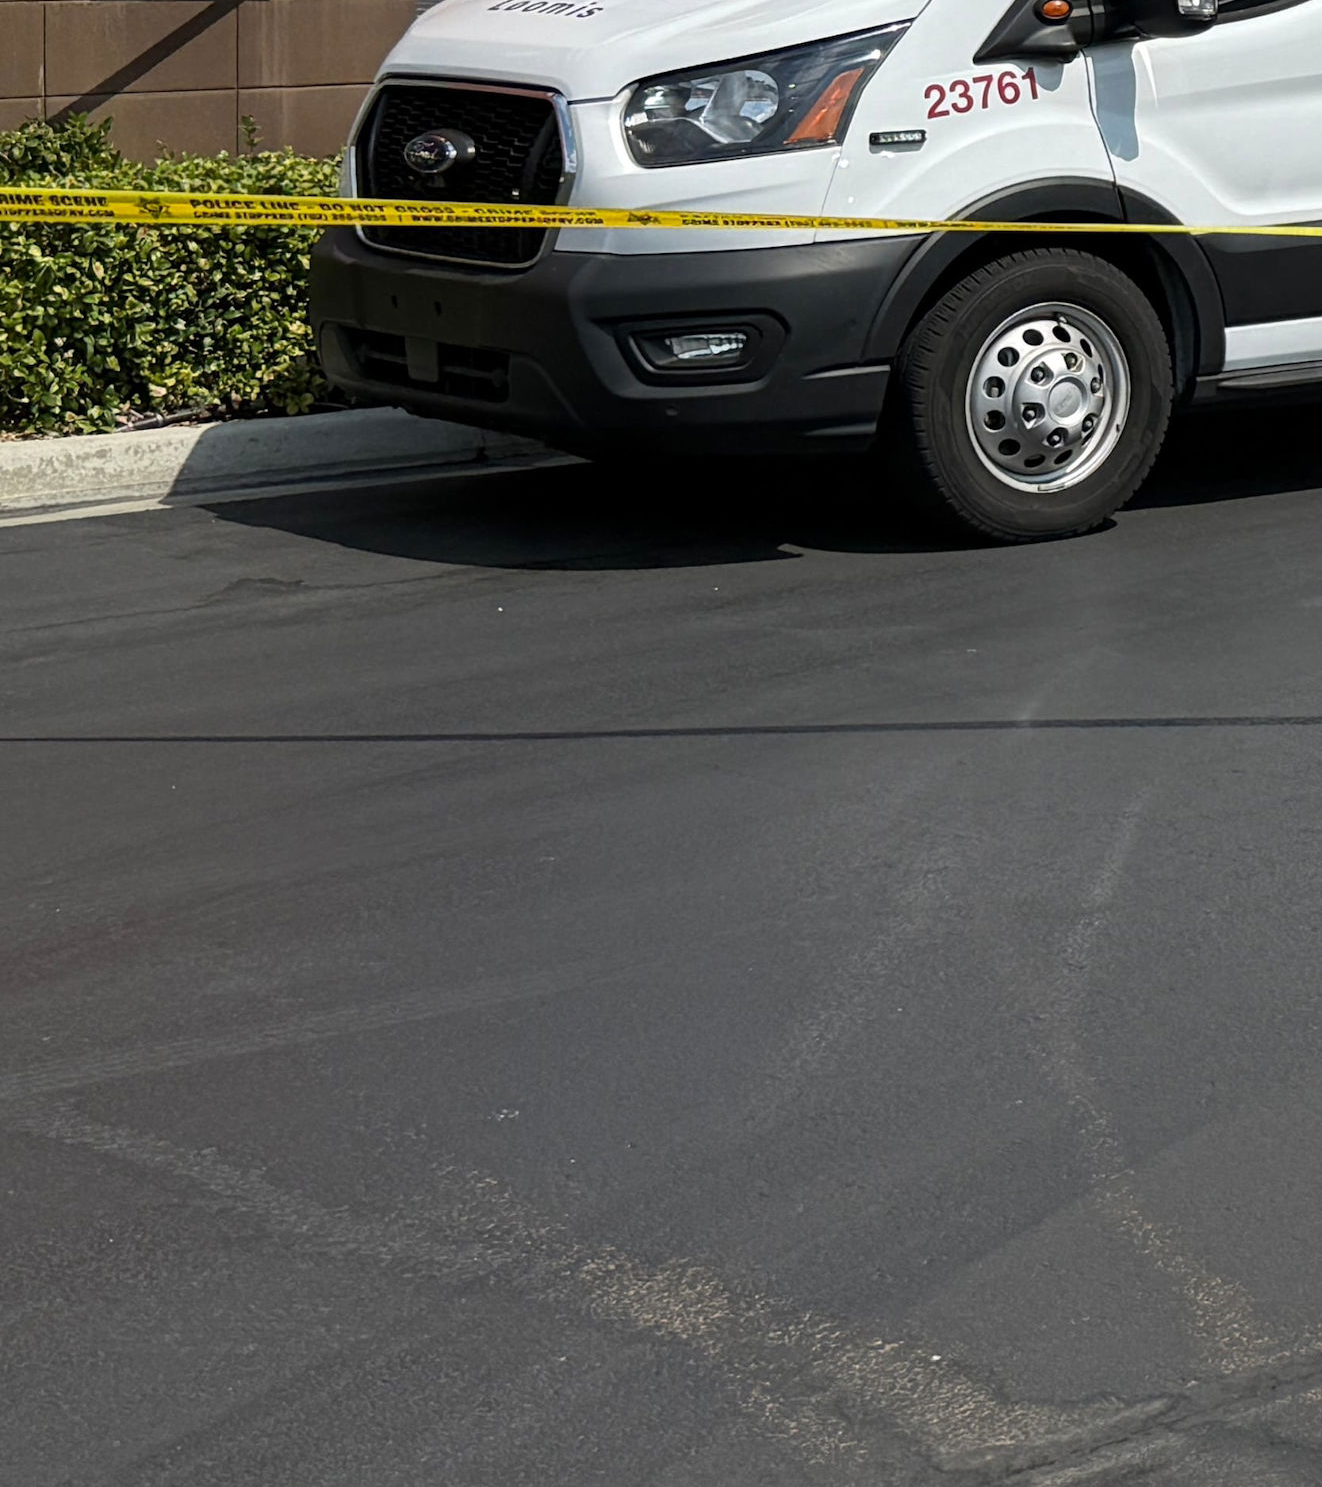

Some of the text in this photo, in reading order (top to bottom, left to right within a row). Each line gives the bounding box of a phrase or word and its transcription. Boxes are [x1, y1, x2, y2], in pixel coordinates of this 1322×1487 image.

[924, 67, 1038, 119] 23761
[48, 195, 109, 207] SCENE
[189, 198, 254, 211] POLICE
[259, 201, 300, 211] LINE
